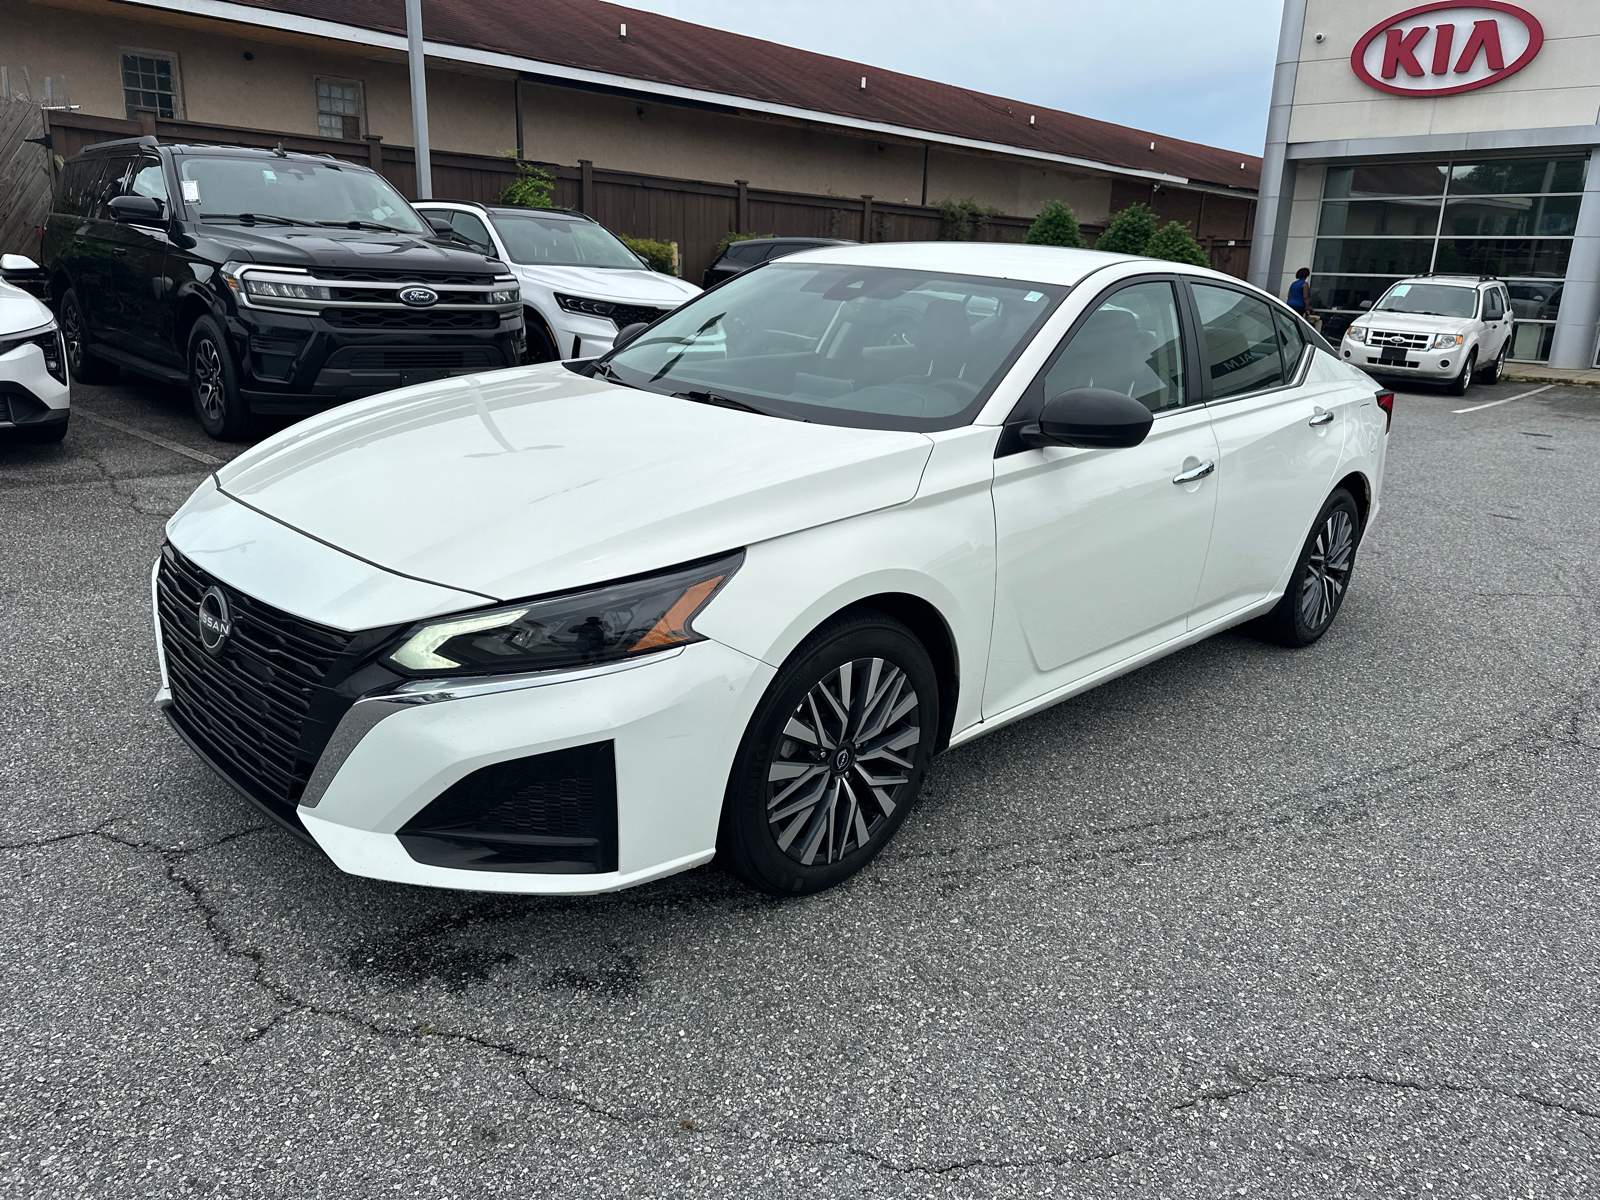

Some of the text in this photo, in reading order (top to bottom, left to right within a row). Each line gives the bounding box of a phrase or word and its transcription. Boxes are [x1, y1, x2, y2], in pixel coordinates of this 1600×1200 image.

[1381, 19, 1504, 79] KIA
[410, 291, 430, 301] Ford
[201, 611, 229, 635] SSAN
